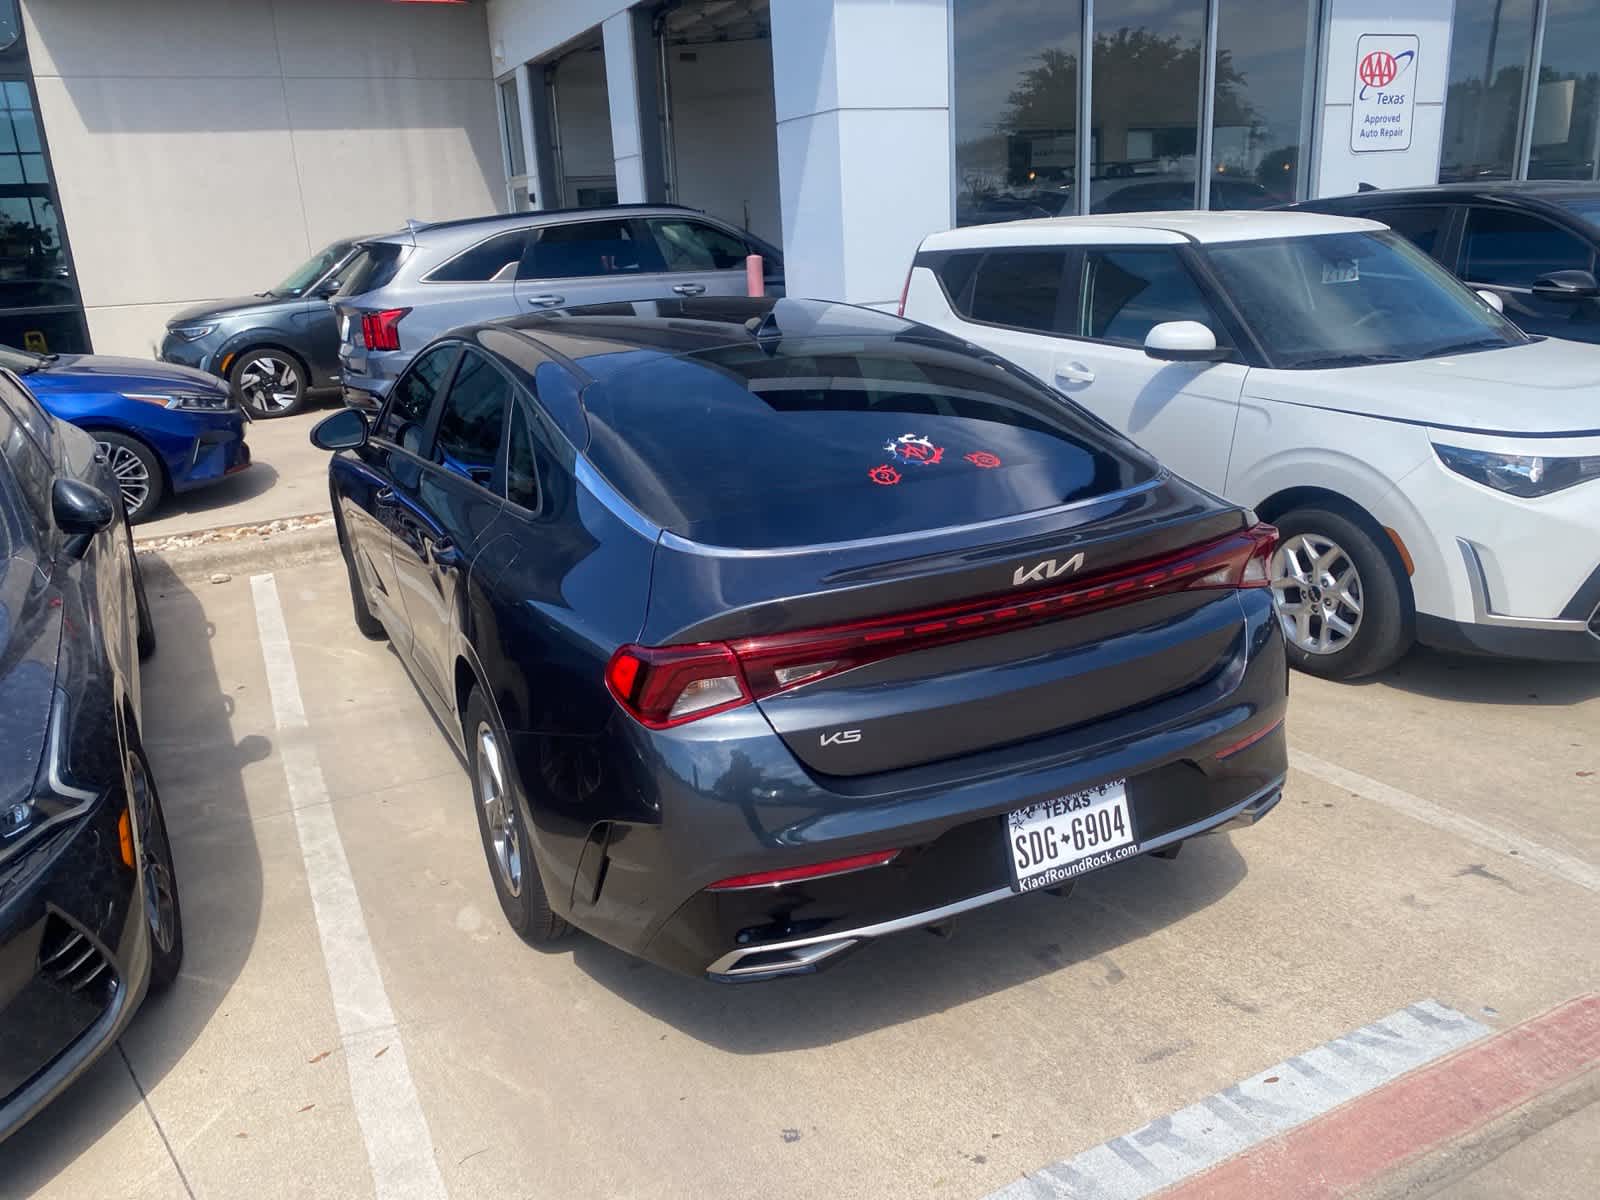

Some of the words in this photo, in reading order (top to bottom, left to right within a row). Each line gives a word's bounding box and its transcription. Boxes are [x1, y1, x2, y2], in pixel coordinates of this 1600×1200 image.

[1362, 52, 1394, 87] AAA
[1376, 92, 1405, 105] Texas
[1364, 113, 1401, 126] Approved
[1360, 129, 1379, 138] Auto
[1380, 127, 1404, 139] Repair
[1013, 552, 1085, 586] KIA
[820, 729, 861, 746] K5
[1042, 795, 1091, 819] TEXAS
[1019, 844, 1138, 892] KiaofRoundRock.com
